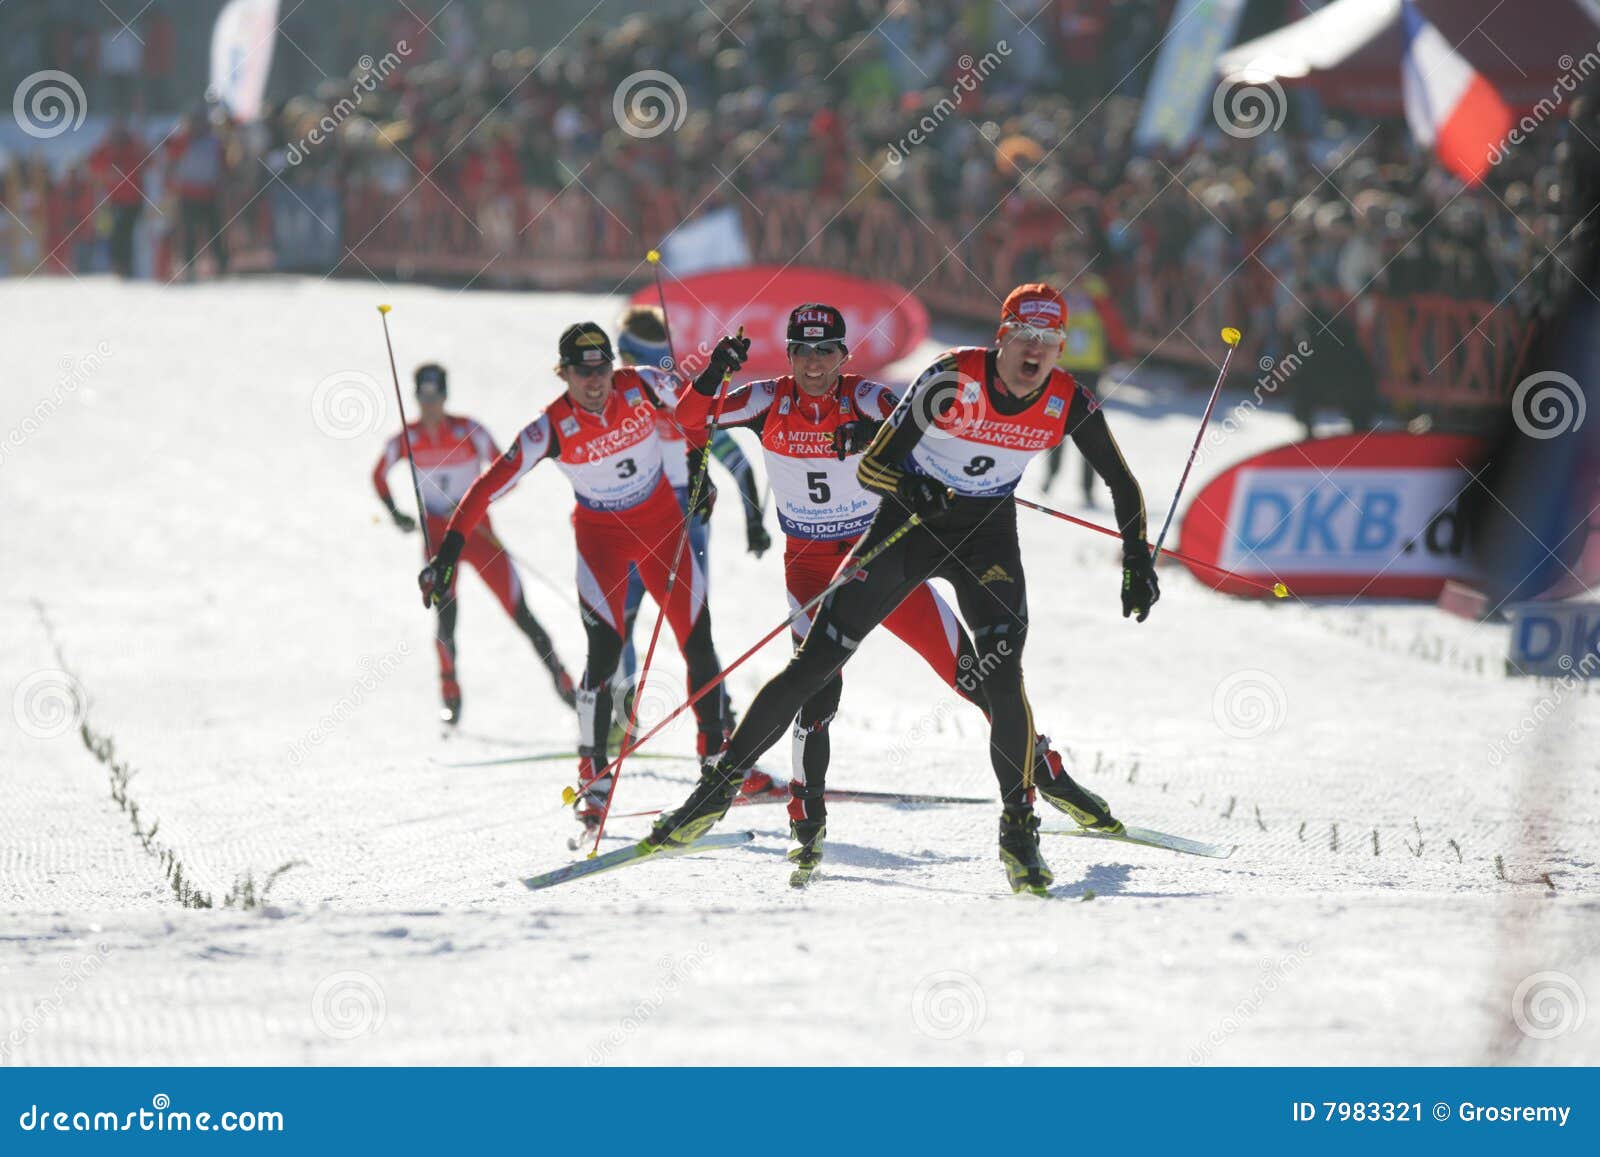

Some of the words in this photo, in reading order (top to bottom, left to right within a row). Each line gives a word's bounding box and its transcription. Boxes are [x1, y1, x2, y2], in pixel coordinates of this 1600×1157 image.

[663, 304, 893, 355] RICH
[788, 431, 834, 442] MUTU
[788, 444, 833, 456] FRANÇ
[615, 458, 637, 479] 3
[963, 456, 995, 476] 9
[807, 472, 831, 504] 5
[796, 519, 862, 533] TelDaFax
[1233, 489, 1464, 558] DKB.d
